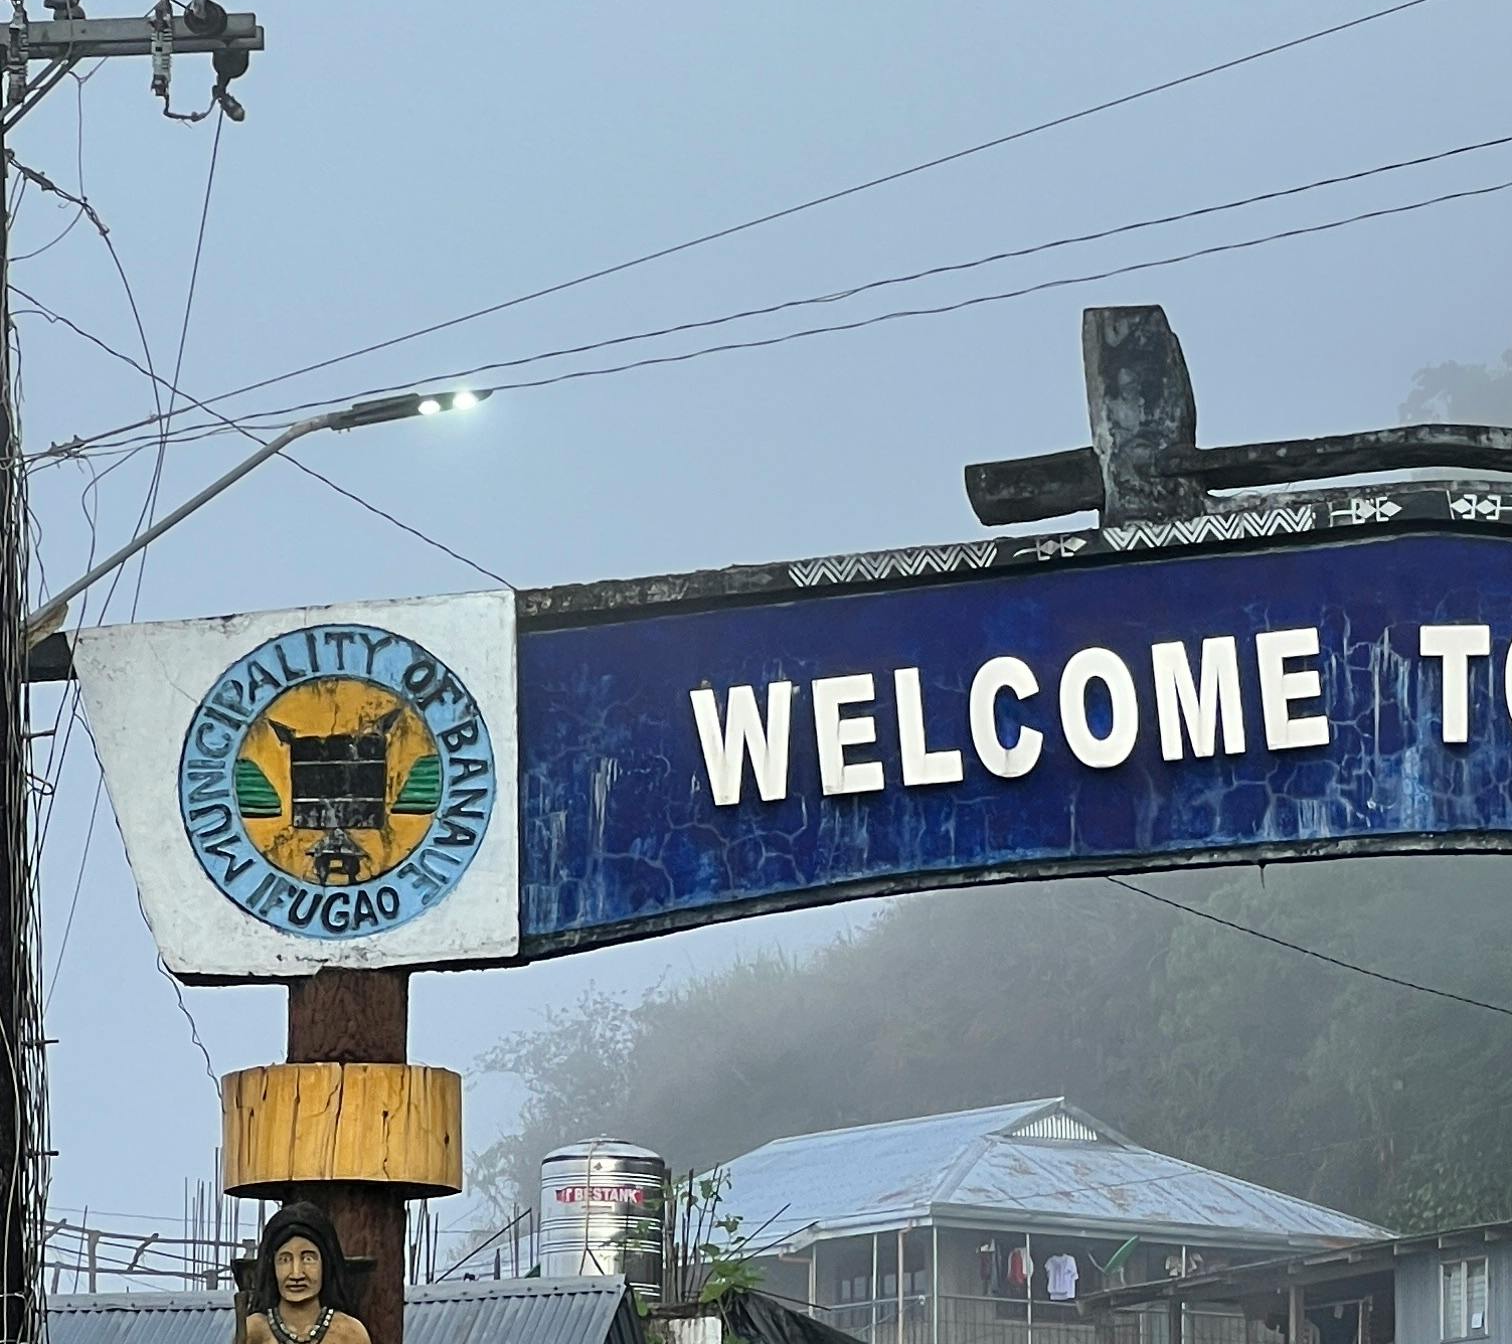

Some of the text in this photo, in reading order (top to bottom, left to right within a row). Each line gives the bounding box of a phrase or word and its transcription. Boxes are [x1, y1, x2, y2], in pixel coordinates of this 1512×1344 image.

[187, 631, 487, 906] MUNICIPALITY OF BANAUE
[689, 627, 1330, 807] WELCOME
[245, 873, 401, 933] IFUGAO
[574, 1187, 638, 1204] BESTANK
